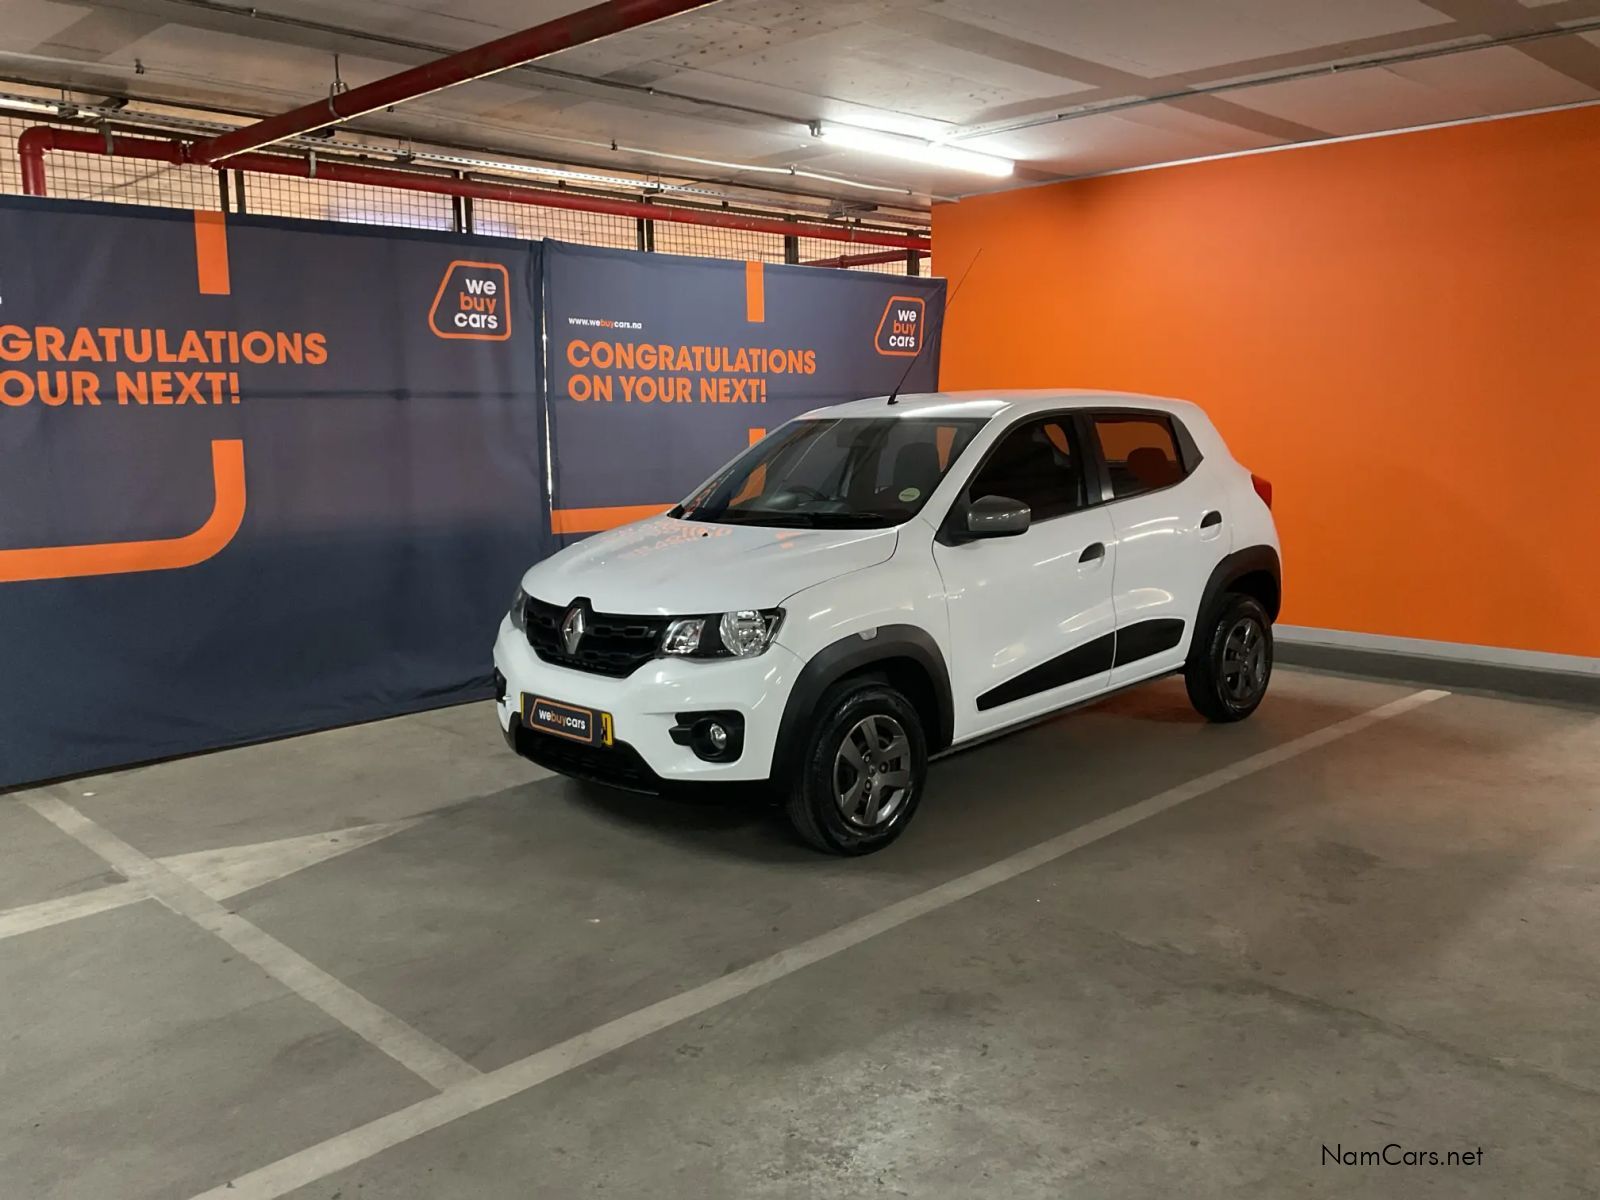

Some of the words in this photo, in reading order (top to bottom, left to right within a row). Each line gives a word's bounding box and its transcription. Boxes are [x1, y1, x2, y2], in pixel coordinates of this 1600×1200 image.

[465, 278, 497, 296] we
[459, 291, 497, 314] buy
[454, 312, 498, 329] cars
[568, 317, 642, 329] www.webuycars.na
[897, 309, 917, 322] we
[893, 320, 916, 336] buy
[0, 324, 328, 365] GRATULATIONS
[889, 335, 915, 347] cars
[566, 339, 817, 375] CONGRATULATIONS
[0, 370, 102, 406] OUR
[116, 371, 241, 405] NEXT!
[568, 374, 613, 402] ON
[618, 375, 692, 403] YOUR
[700, 378, 767, 403] NEXT!
[538, 708, 586, 730] webuycars
